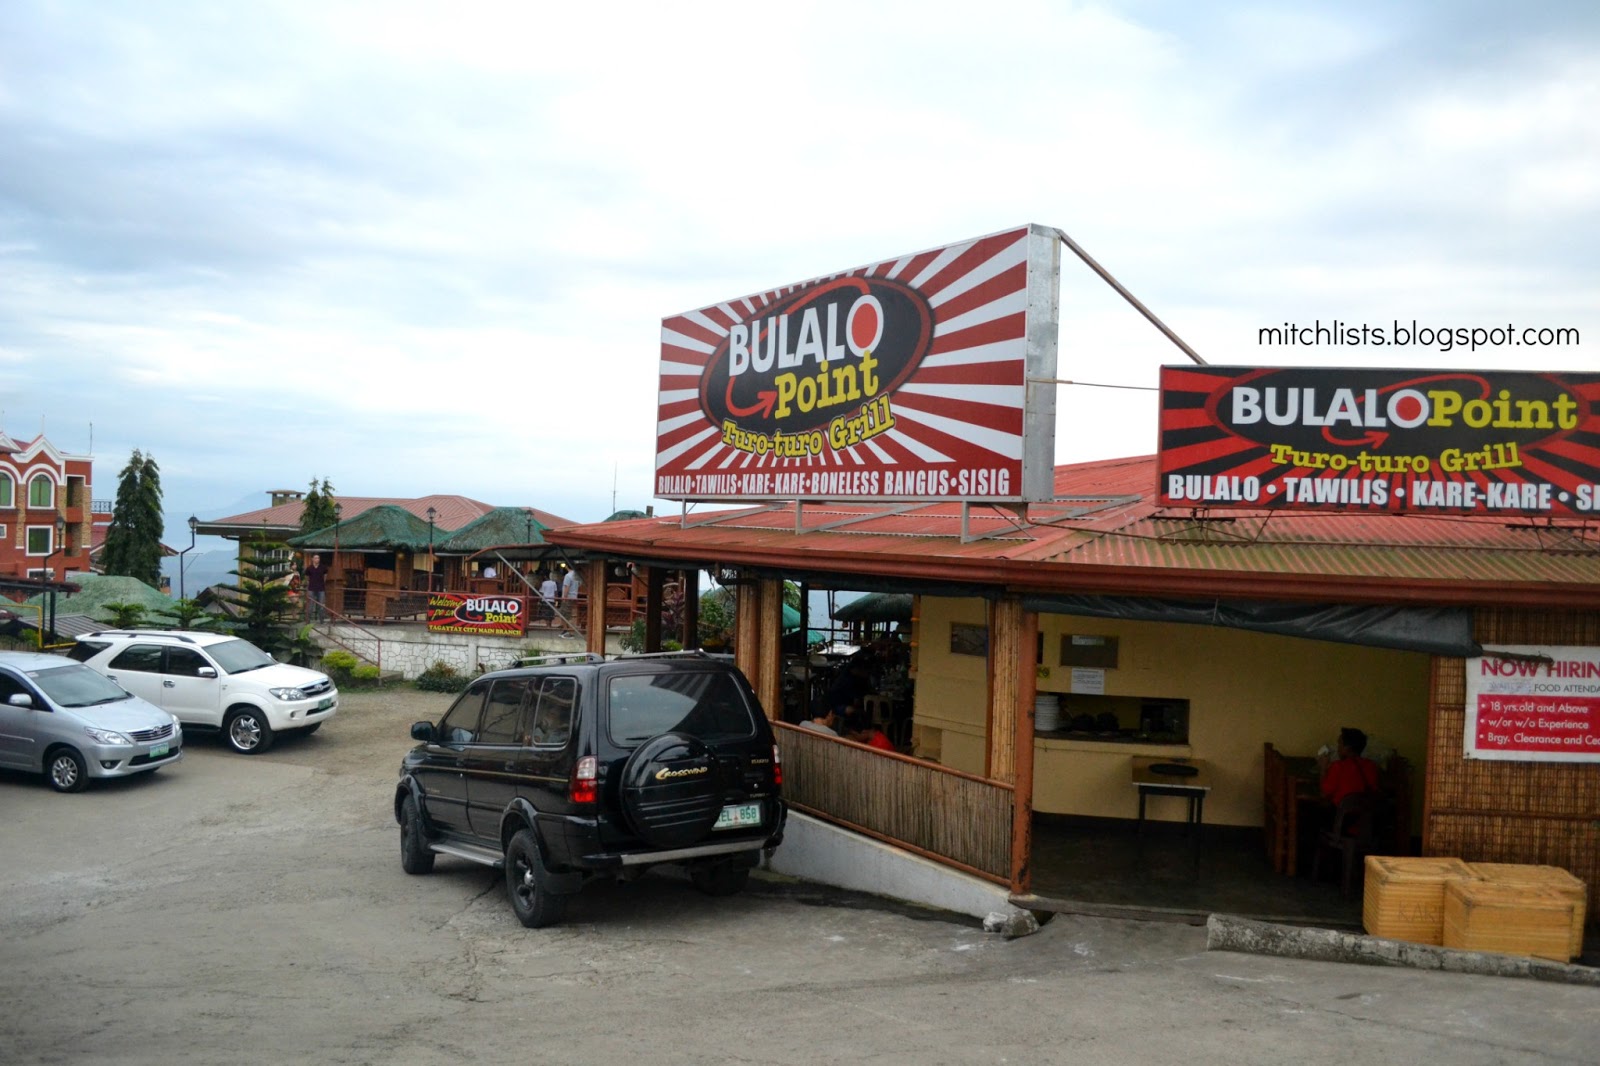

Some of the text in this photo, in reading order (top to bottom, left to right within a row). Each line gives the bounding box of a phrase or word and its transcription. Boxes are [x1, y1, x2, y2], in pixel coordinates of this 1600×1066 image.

[729, 294, 884, 377] BULALO
[774, 350, 879, 419] Point
[1231, 386, 1578, 430] BULALO Point
[721, 392, 896, 458] Turo-turo Grill
[1269, 441, 1523, 474] Turo-turo Grill
[658, 468, 1010, 496] BULALO TAWILIS KARE-KARE BONELESS BANGUS SISIG
[1168, 474, 1260, 502] BULALO
[1283, 477, 1388, 505] TAWILIS
[1412, 480, 1552, 510] KARE-KARE
[466, 599, 519, 614] BULALO
[485, 612, 517, 624] Point
[478, 627, 495, 635] MAIN
[495, 628, 522, 636] BRANCH
[1481, 658, 1540, 677] NOW
[1534, 683, 1561, 693] FOOD
[1490, 701, 1501, 711] 18
[1536, 702, 1556, 713] and
[1558, 703, 1589, 714] Above
[1515, 717, 1536, 729] w/o
[1538, 718, 1590, 731] Experience
[1487, 732, 1511, 745] Brgy.
[1513, 732, 1562, 744] Clearance
[1563, 734, 1583, 745] and
